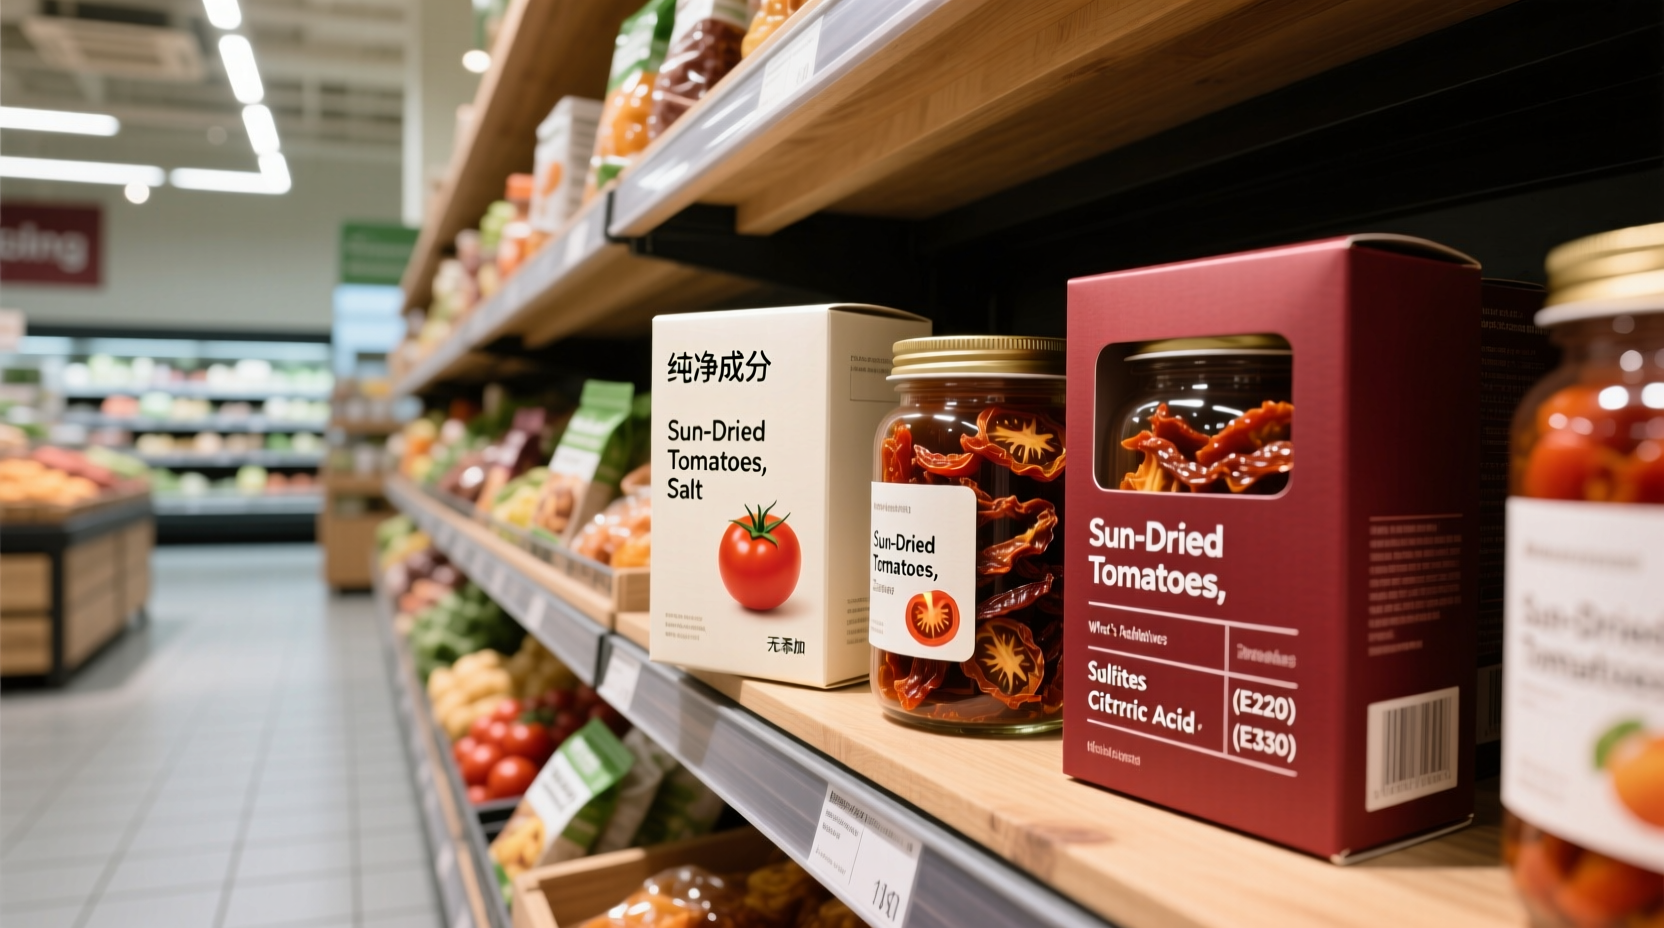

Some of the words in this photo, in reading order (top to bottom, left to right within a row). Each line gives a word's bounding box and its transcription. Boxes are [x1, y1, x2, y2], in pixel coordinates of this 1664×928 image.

[667, 350, 772, 384] 纯净成分
[667, 419, 766, 442] Sun-Dried
[667, 449, 768, 477] Tomatoes,
[667, 478, 704, 500] Salt
[873, 529, 936, 555] Sun-Dried
[1088, 517, 1224, 558] Sun-Dried
[873, 553, 939, 582] Tomatoes,
[1088, 555, 1227, 606] Tomatoes,
[1232, 688, 1297, 726] (E220)
[1232, 722, 1297, 764] (E330)
